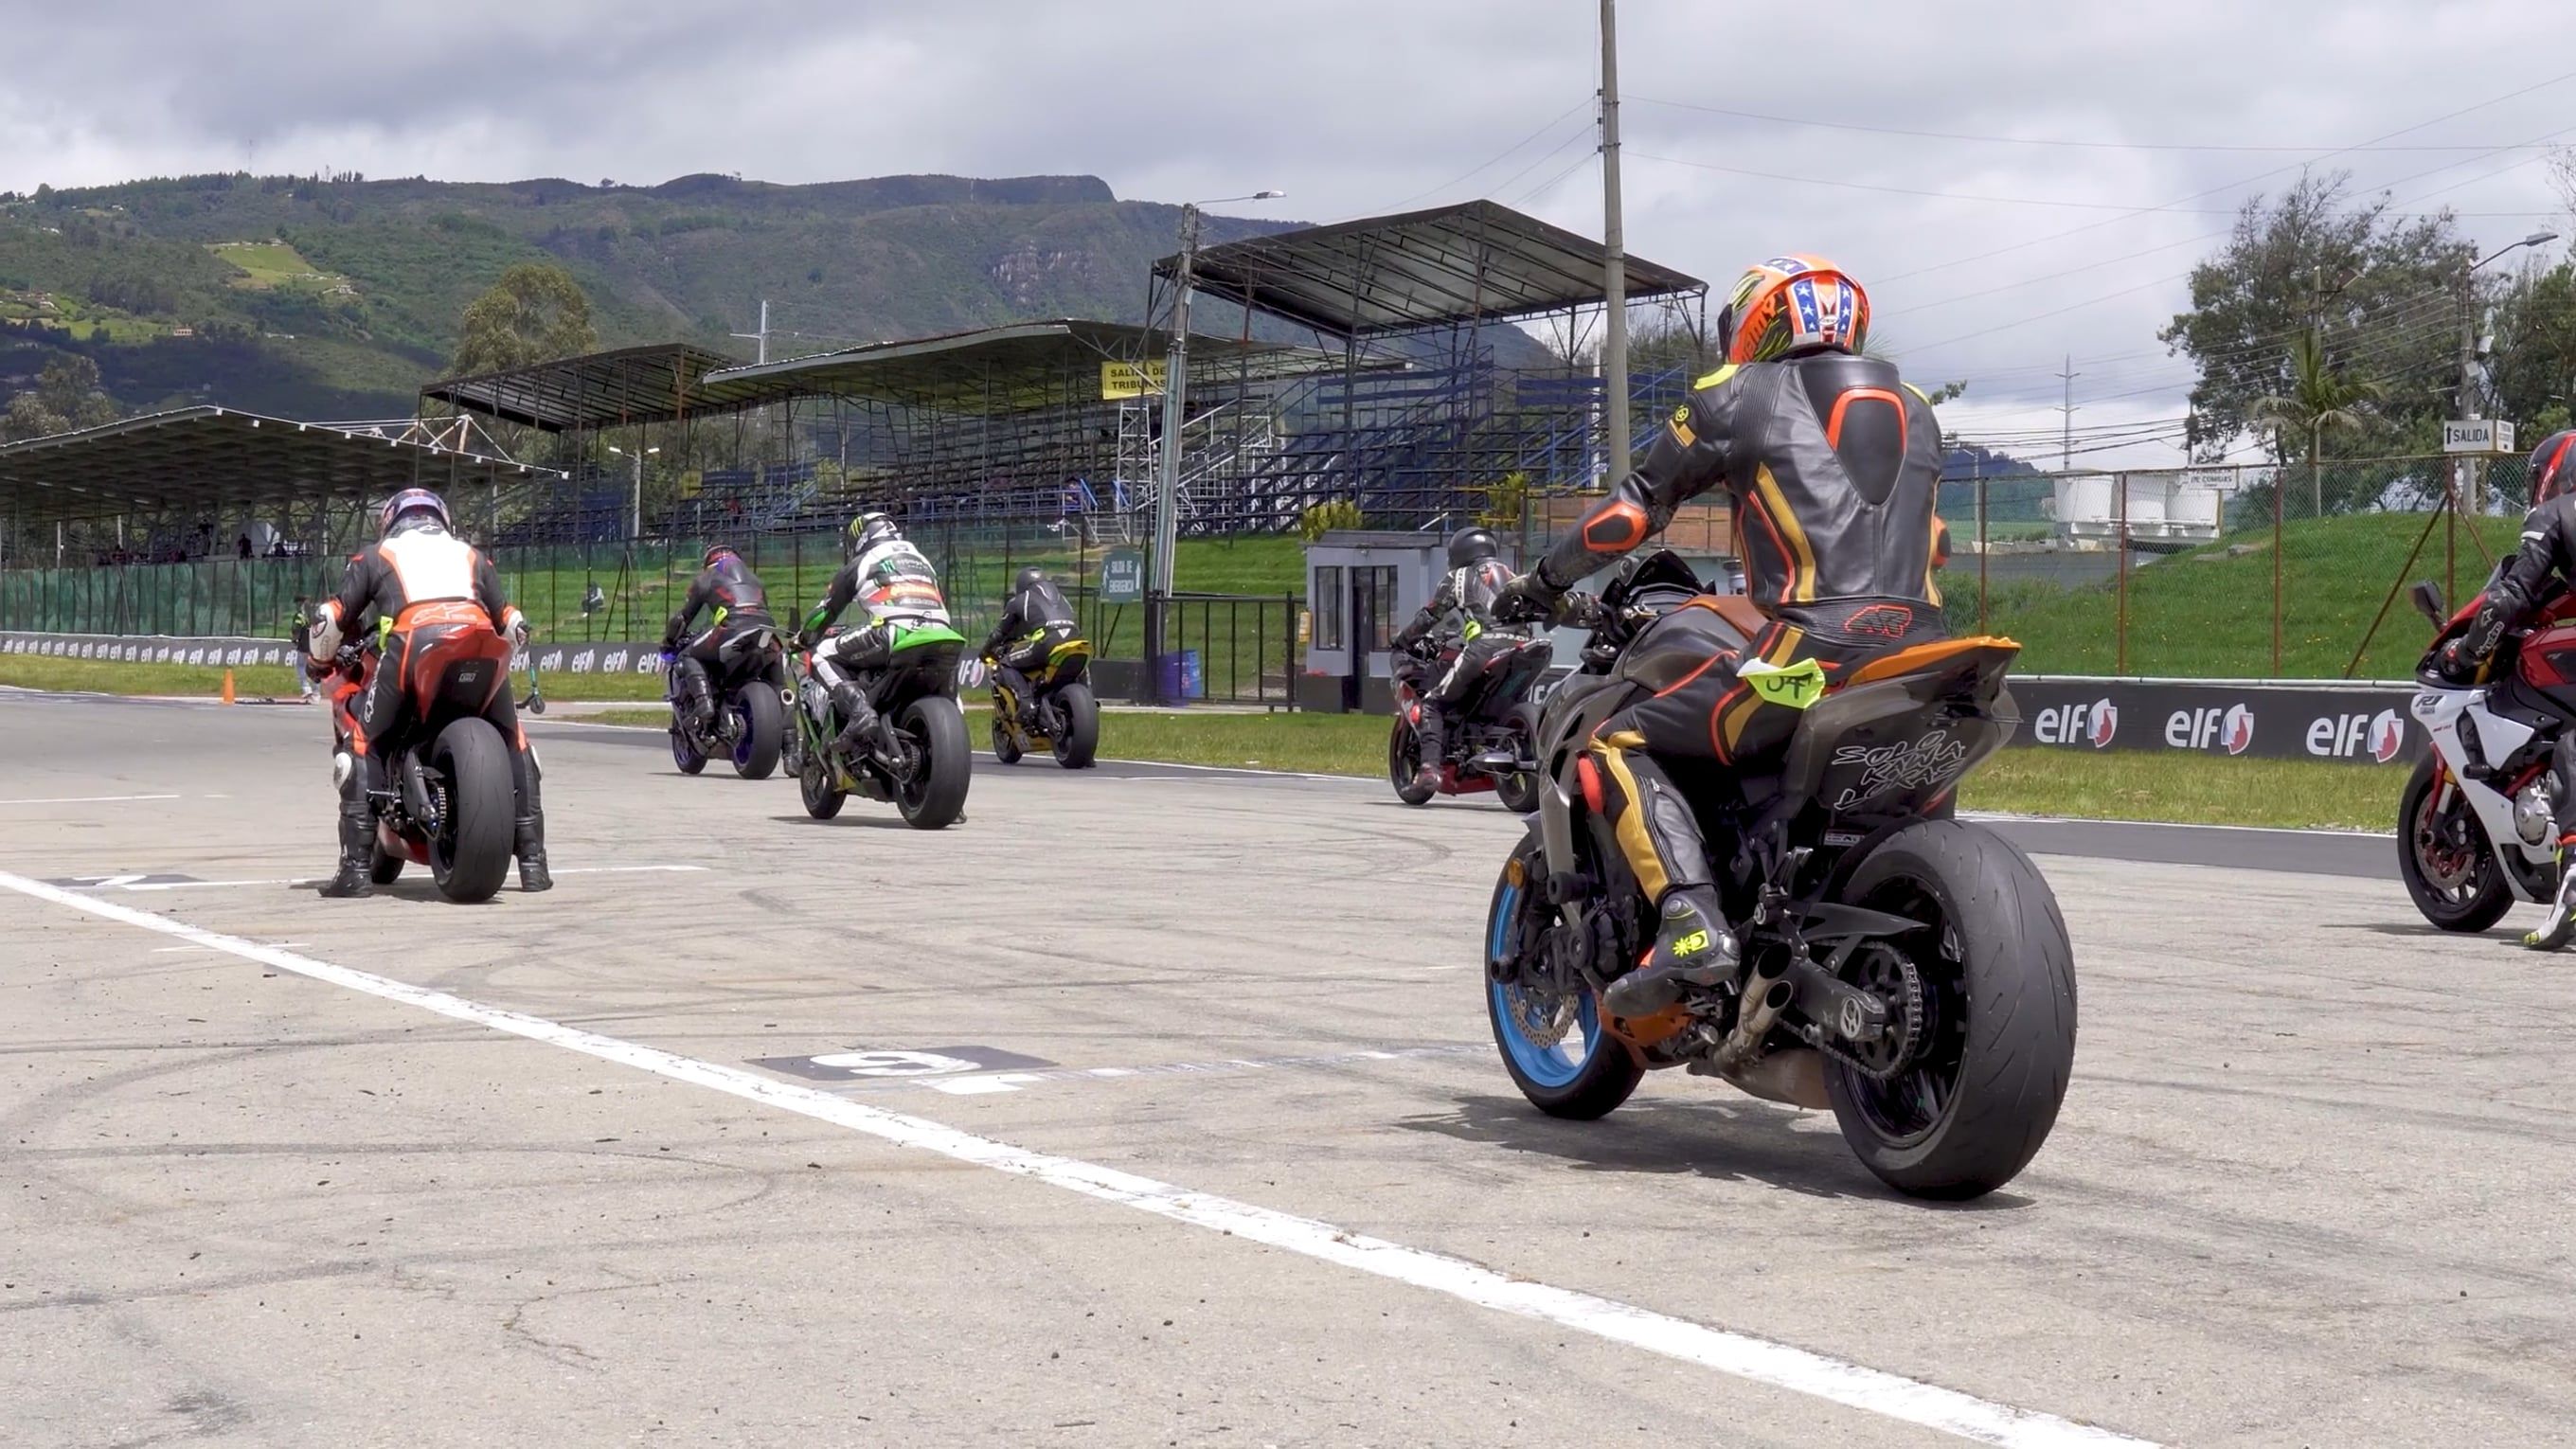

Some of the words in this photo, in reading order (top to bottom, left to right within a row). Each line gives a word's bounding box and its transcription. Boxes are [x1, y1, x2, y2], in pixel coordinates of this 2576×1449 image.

[1153, 366, 1166, 376] DE
[1111, 379, 1167, 389] TRIBUNAS
[2453, 428, 2490, 442] SALIDA
[603, 652, 621, 672] elf
[637, 653, 657, 674] elf
[957, 660, 974, 685] lf
[2034, 704, 2087, 743] elf
[2165, 707, 2222, 749] elf
[2306, 713, 2369, 757] elf
